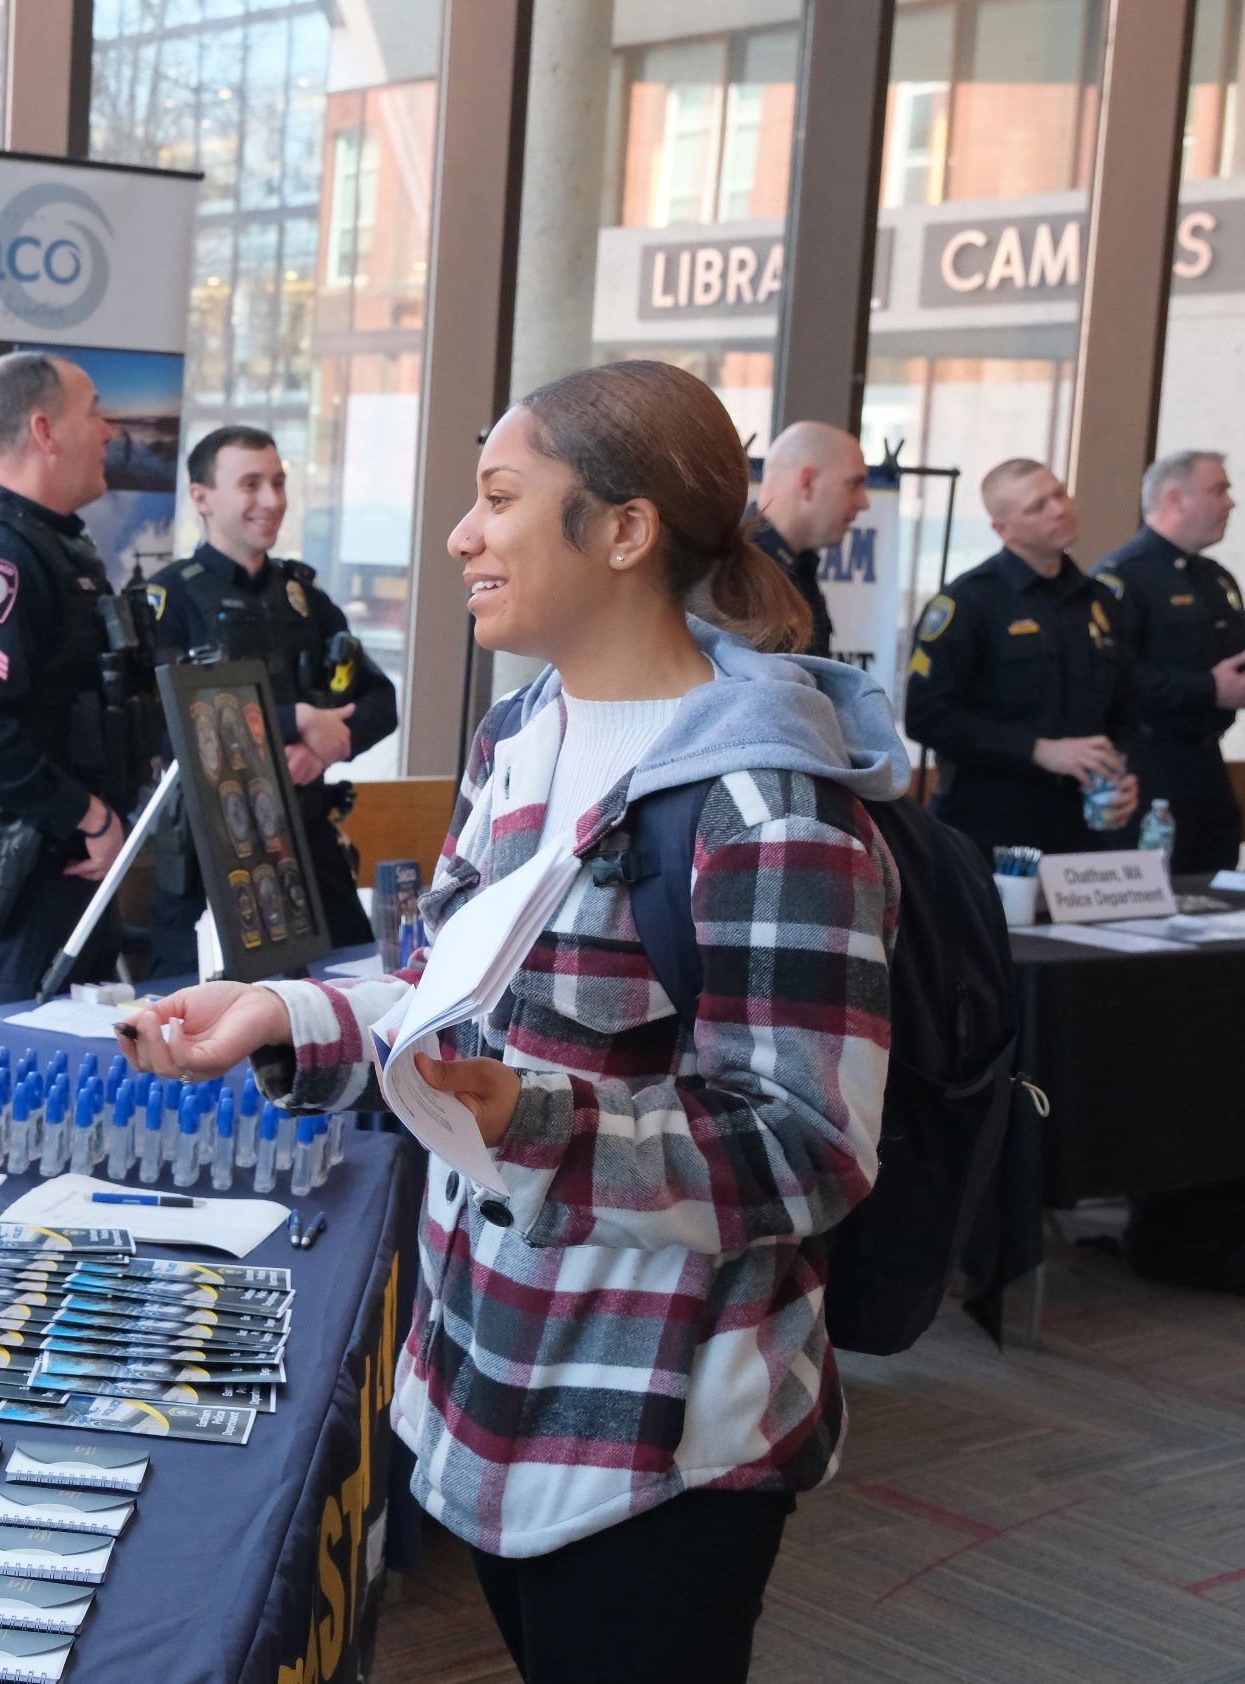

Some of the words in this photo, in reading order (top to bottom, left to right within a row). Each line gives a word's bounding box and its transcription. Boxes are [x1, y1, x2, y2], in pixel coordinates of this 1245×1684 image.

[651, 243, 783, 309] LIBRA
[818, 527, 876, 583] AM
[1063, 866, 1122, 884] Chatham,
[1122, 864, 1143, 881] MA
[1056, 890, 1092, 908] Police
[1093, 887, 1164, 907] Department
